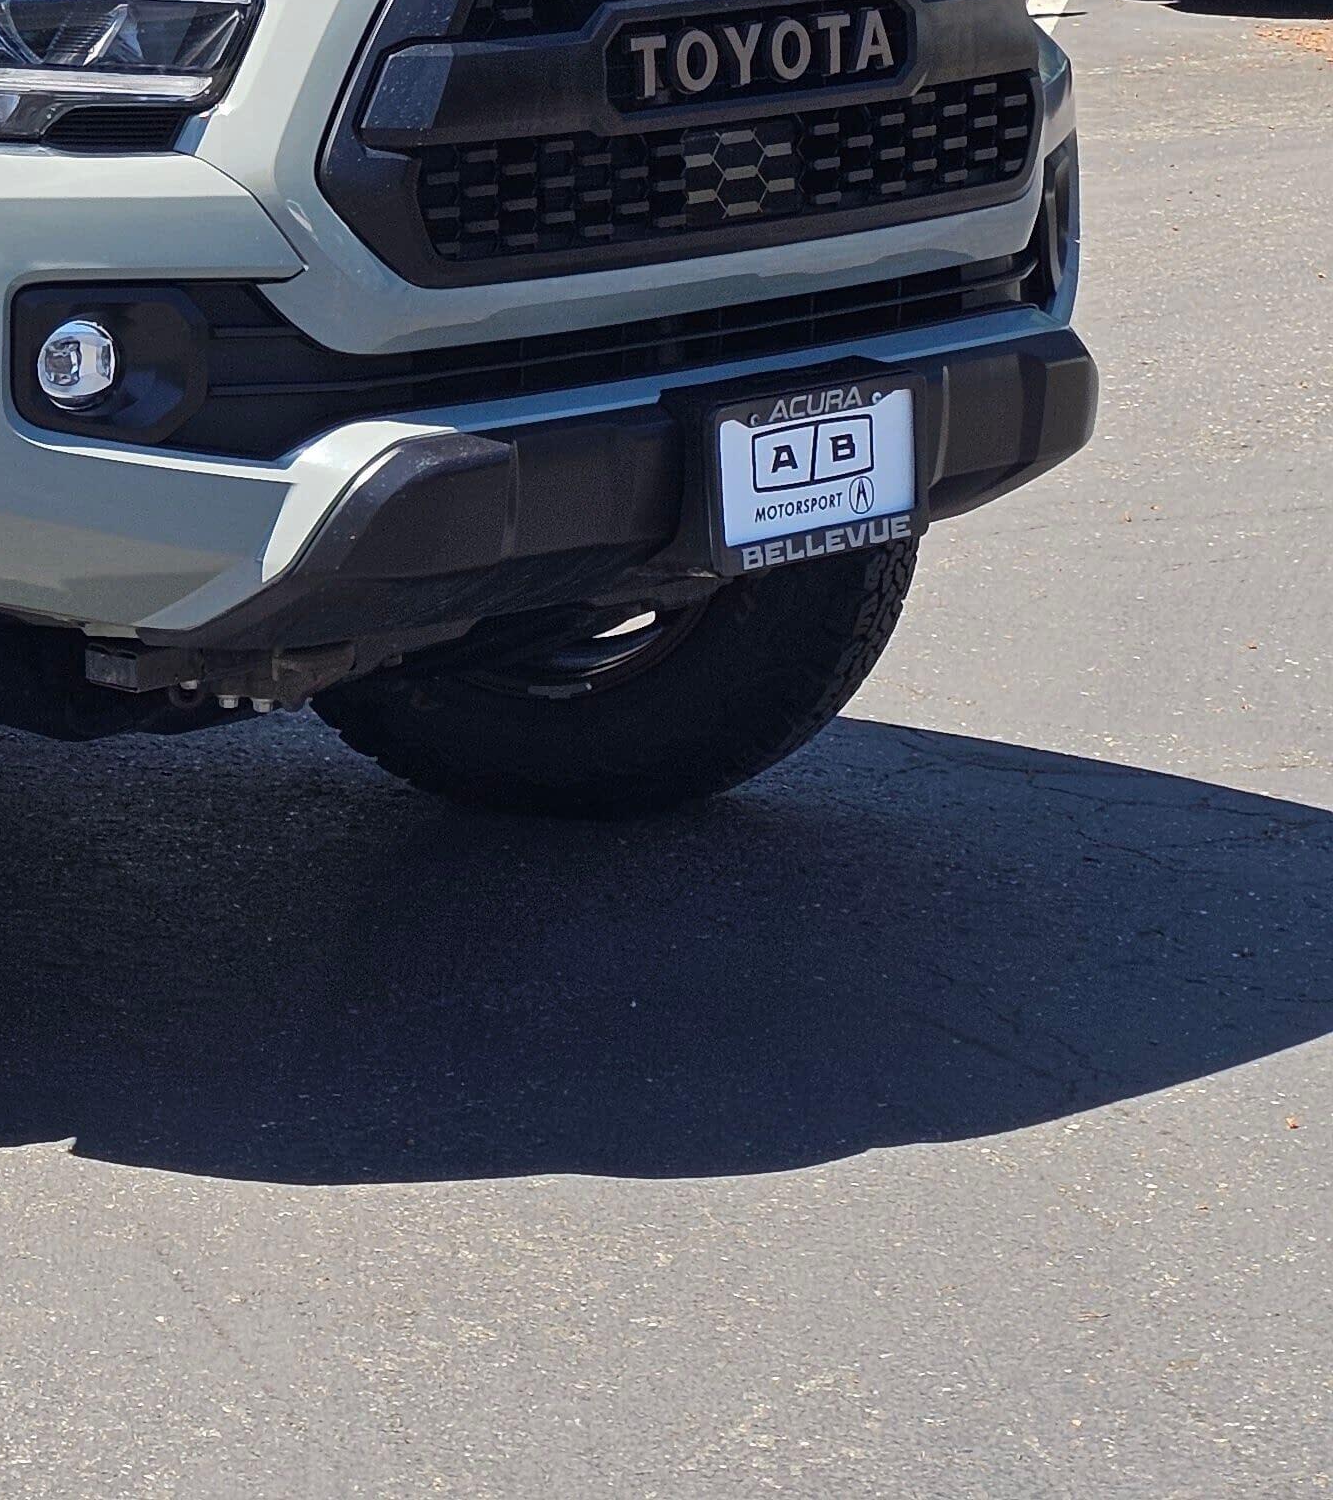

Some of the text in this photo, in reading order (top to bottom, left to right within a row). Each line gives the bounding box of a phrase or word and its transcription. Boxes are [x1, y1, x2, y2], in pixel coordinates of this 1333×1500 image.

[630, 8, 895, 98] TOYOTA
[768, 386, 863, 423] ACURA
[772, 434, 855, 473] A B
[754, 491, 843, 523] MOTORSPORT
[740, 515, 912, 571] BELLEVUE
